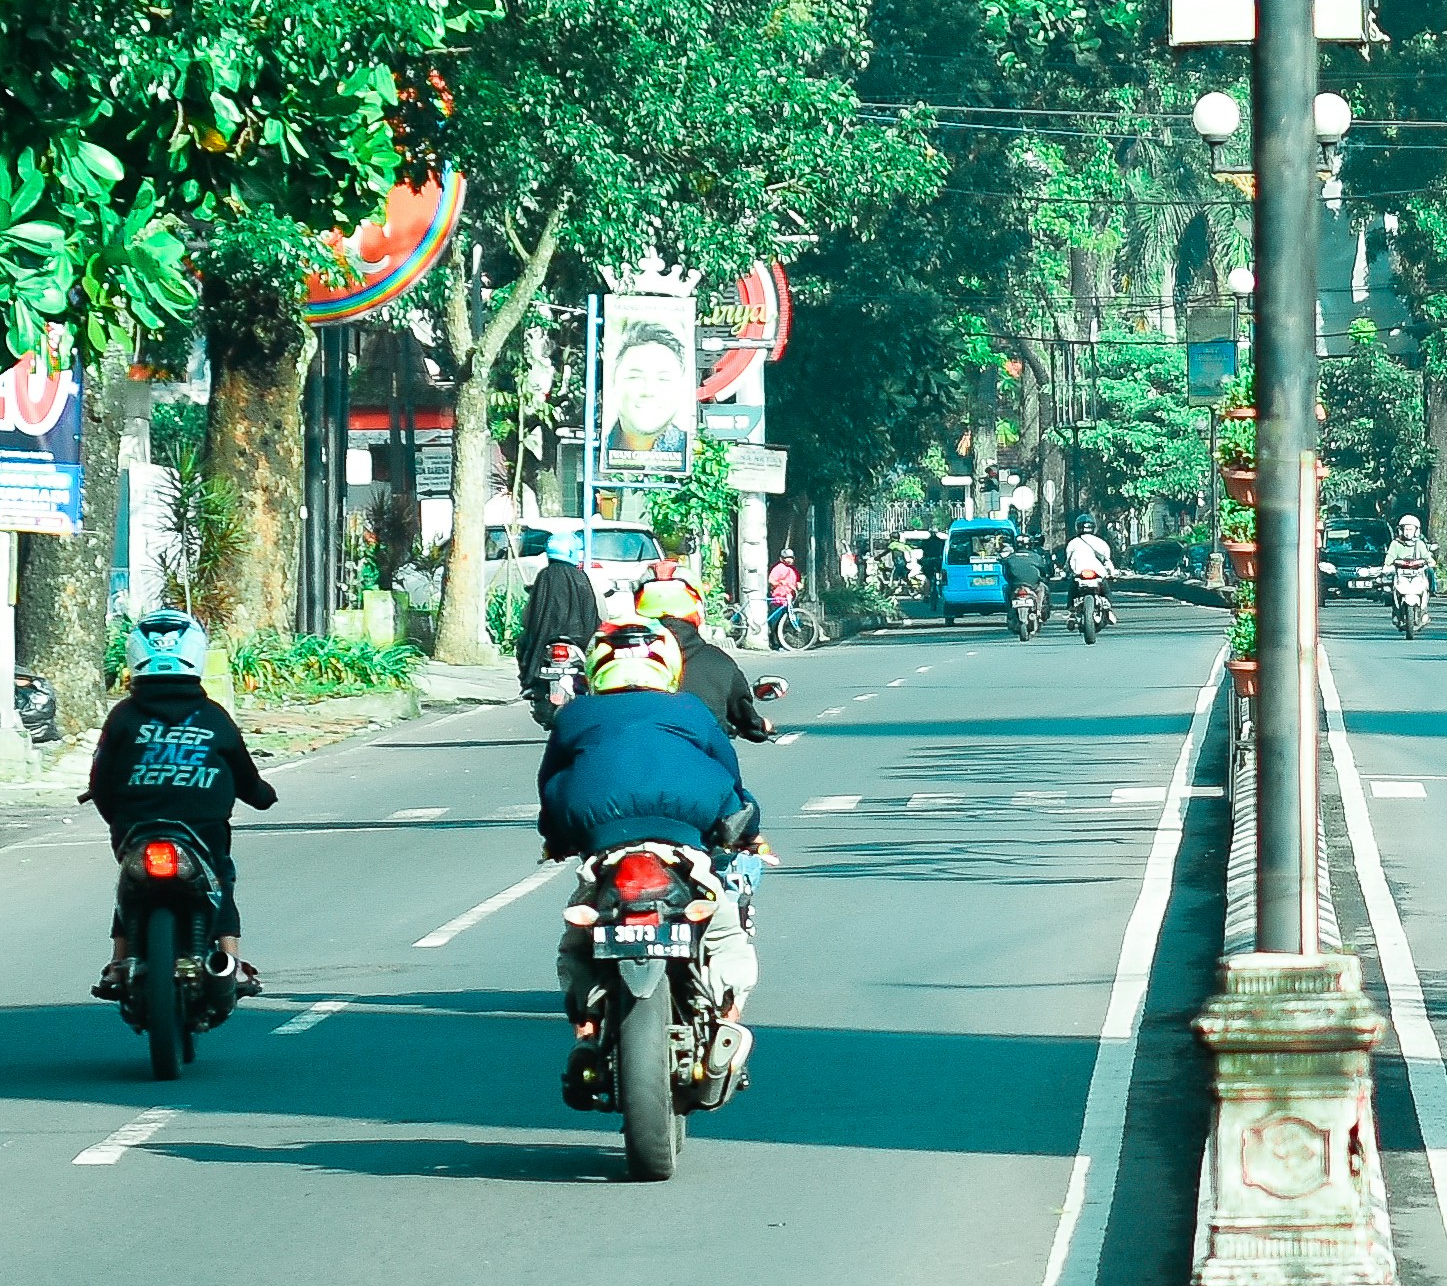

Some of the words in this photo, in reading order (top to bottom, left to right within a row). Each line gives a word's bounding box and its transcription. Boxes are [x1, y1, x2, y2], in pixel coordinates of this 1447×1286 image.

[135, 724, 214, 745] SLEEP
[140, 743, 210, 765] RACE
[128, 764, 220, 789] REPEAT
